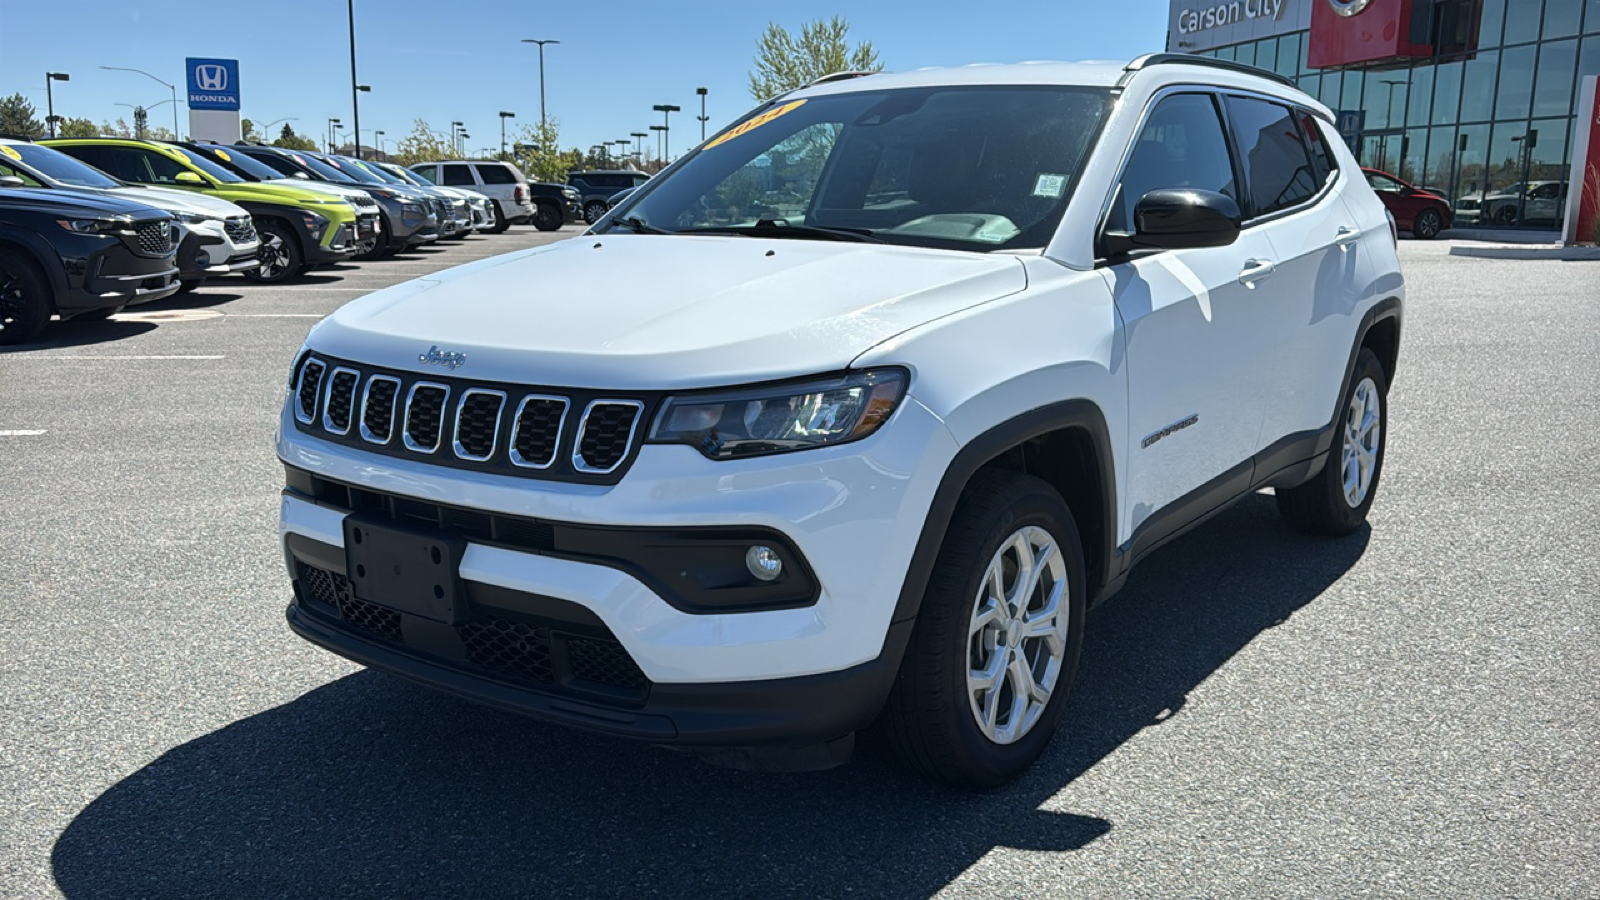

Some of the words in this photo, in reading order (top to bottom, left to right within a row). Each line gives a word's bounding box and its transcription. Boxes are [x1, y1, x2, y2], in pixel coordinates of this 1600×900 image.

[1178, 1, 1240, 34] Carson
[1245, 0, 1280, 20] City
[190, 94, 237, 103] HONDA
[418, 345, 467, 371] Jeep
[1141, 412, 1199, 449] COMPASS
